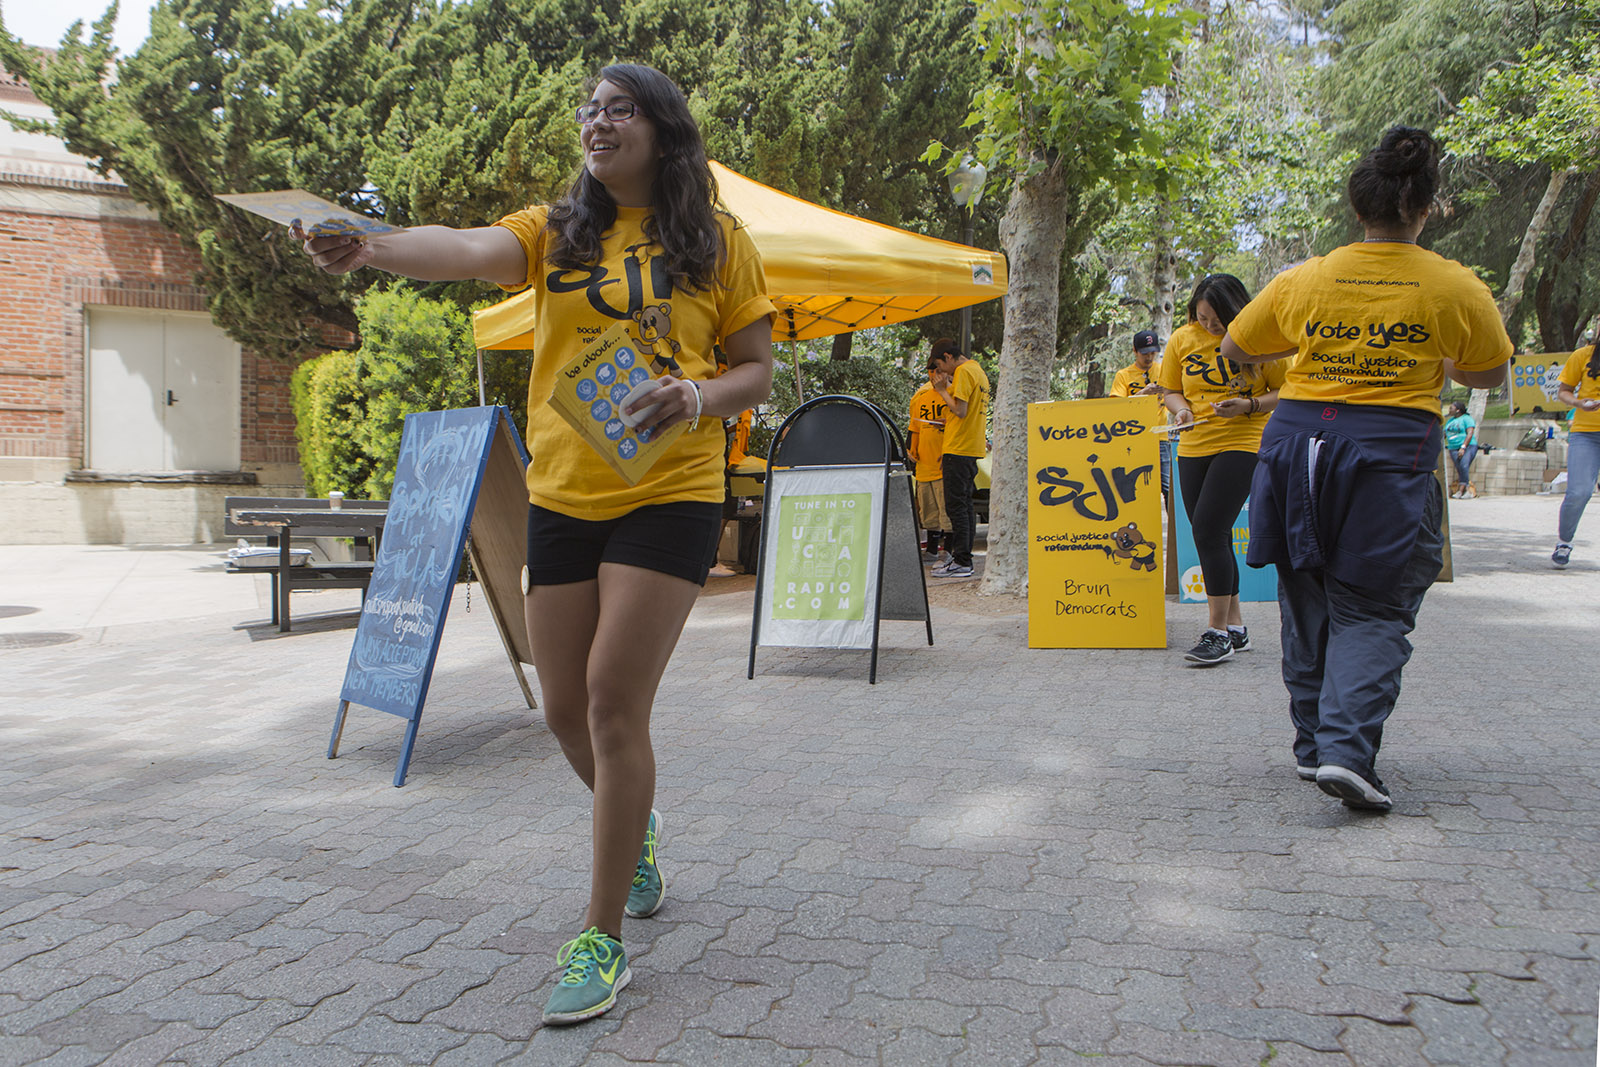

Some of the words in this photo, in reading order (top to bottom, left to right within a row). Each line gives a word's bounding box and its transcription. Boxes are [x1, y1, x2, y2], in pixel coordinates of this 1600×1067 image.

[1305, 319, 1361, 340] Vote
[1366, 321, 1431, 349] yes
[1311, 352, 1356, 365] social
[1359, 354, 1417, 369] justice
[565, 365, 582, 378] be
[1323, 365, 1399, 378] referendum
[1039, 425, 1088, 441] Vote
[1092, 419, 1146, 443] yes
[1036, 453, 1154, 522] sjr
[794, 501, 821, 511] TUNE
[825, 500, 837, 510] IN
[841, 499, 856, 509] TO
[410, 525, 426, 549] at
[1036, 532, 1069, 542] social
[1070, 531, 1109, 543] justice
[1044, 542, 1105, 552] referendum
[394, 547, 439, 588] UCLA
[787, 582, 850, 595] RADIO
[1064, 579, 1111, 597] Bruin
[1185, 583, 1206, 594] YO
[1055, 599, 1138, 618] Democrats
[344, 667, 369, 690] NEW
[370, 674, 419, 707] MEMBERS
